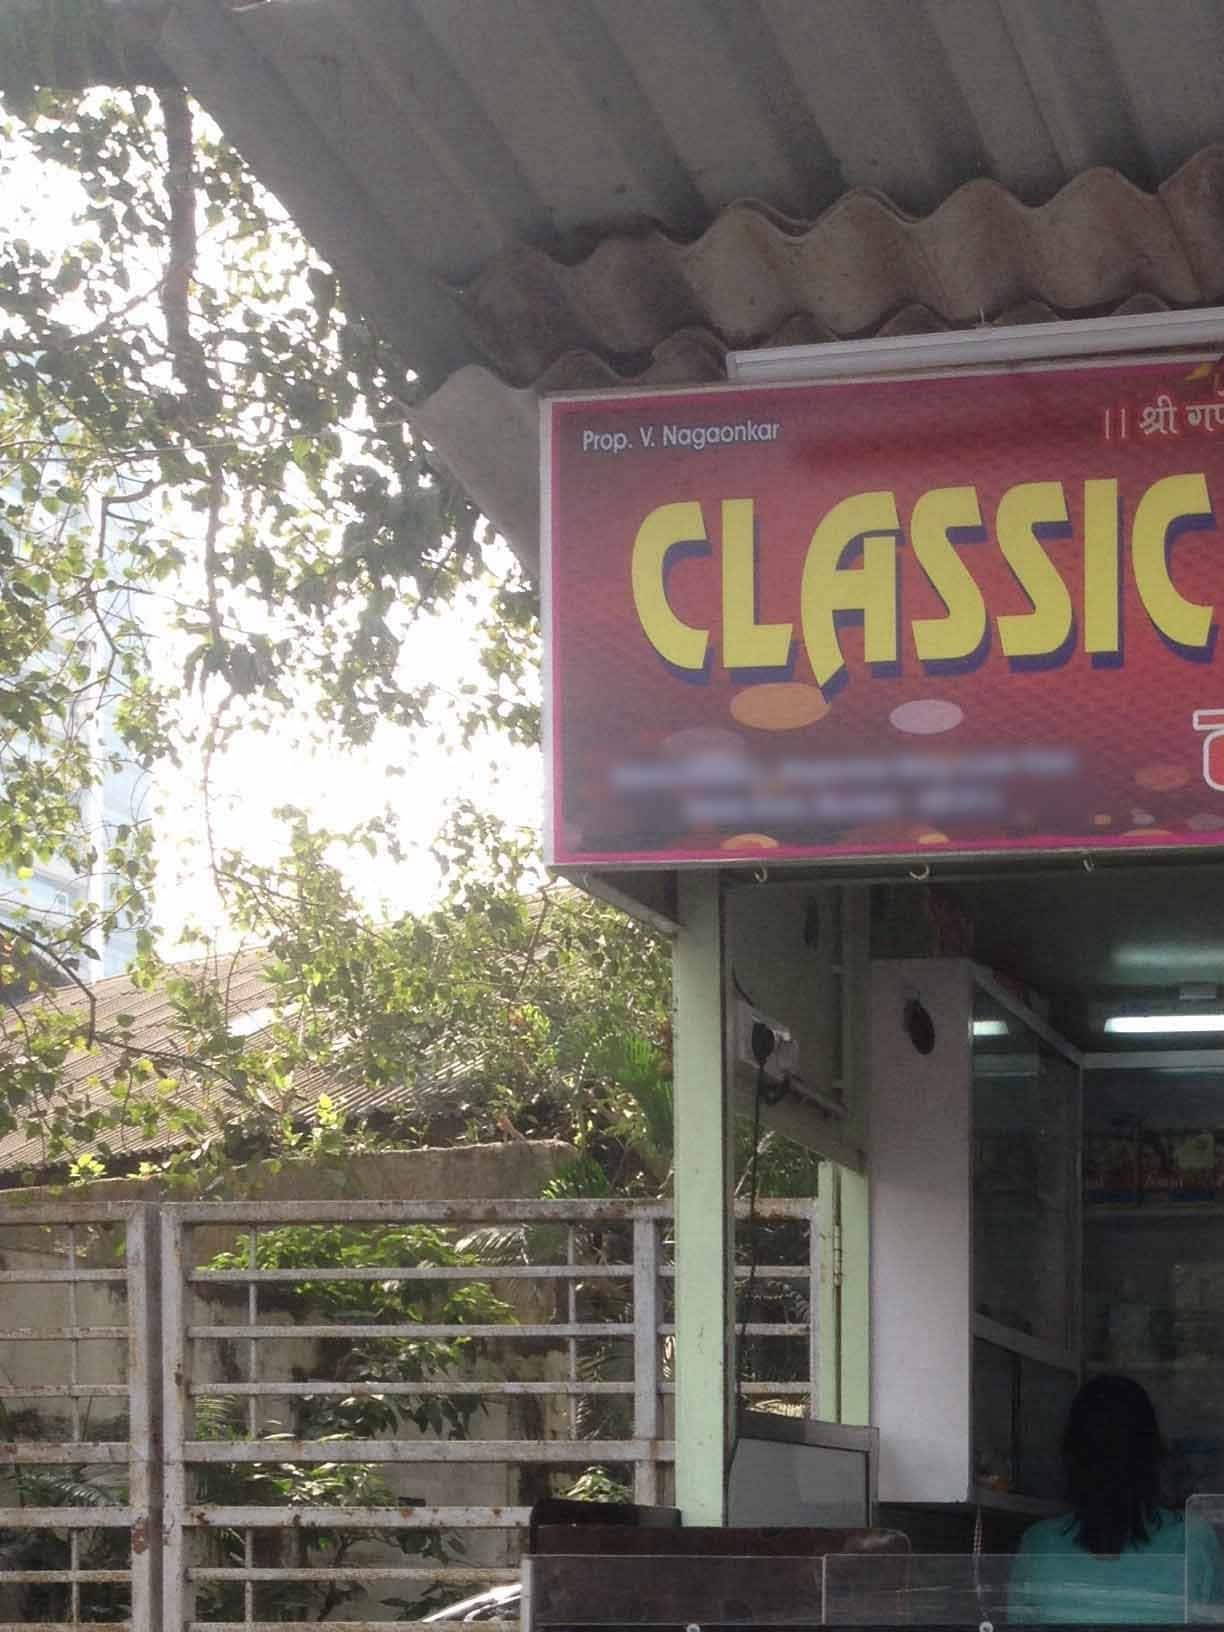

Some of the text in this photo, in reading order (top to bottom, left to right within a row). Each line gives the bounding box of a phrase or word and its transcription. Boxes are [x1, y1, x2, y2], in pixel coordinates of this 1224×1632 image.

[1139, 395, 1178, 434] श्री
[583, 420, 780, 453] Prop. V. Nagaonkar
[632, 473, 1217, 703] CLASSIC
